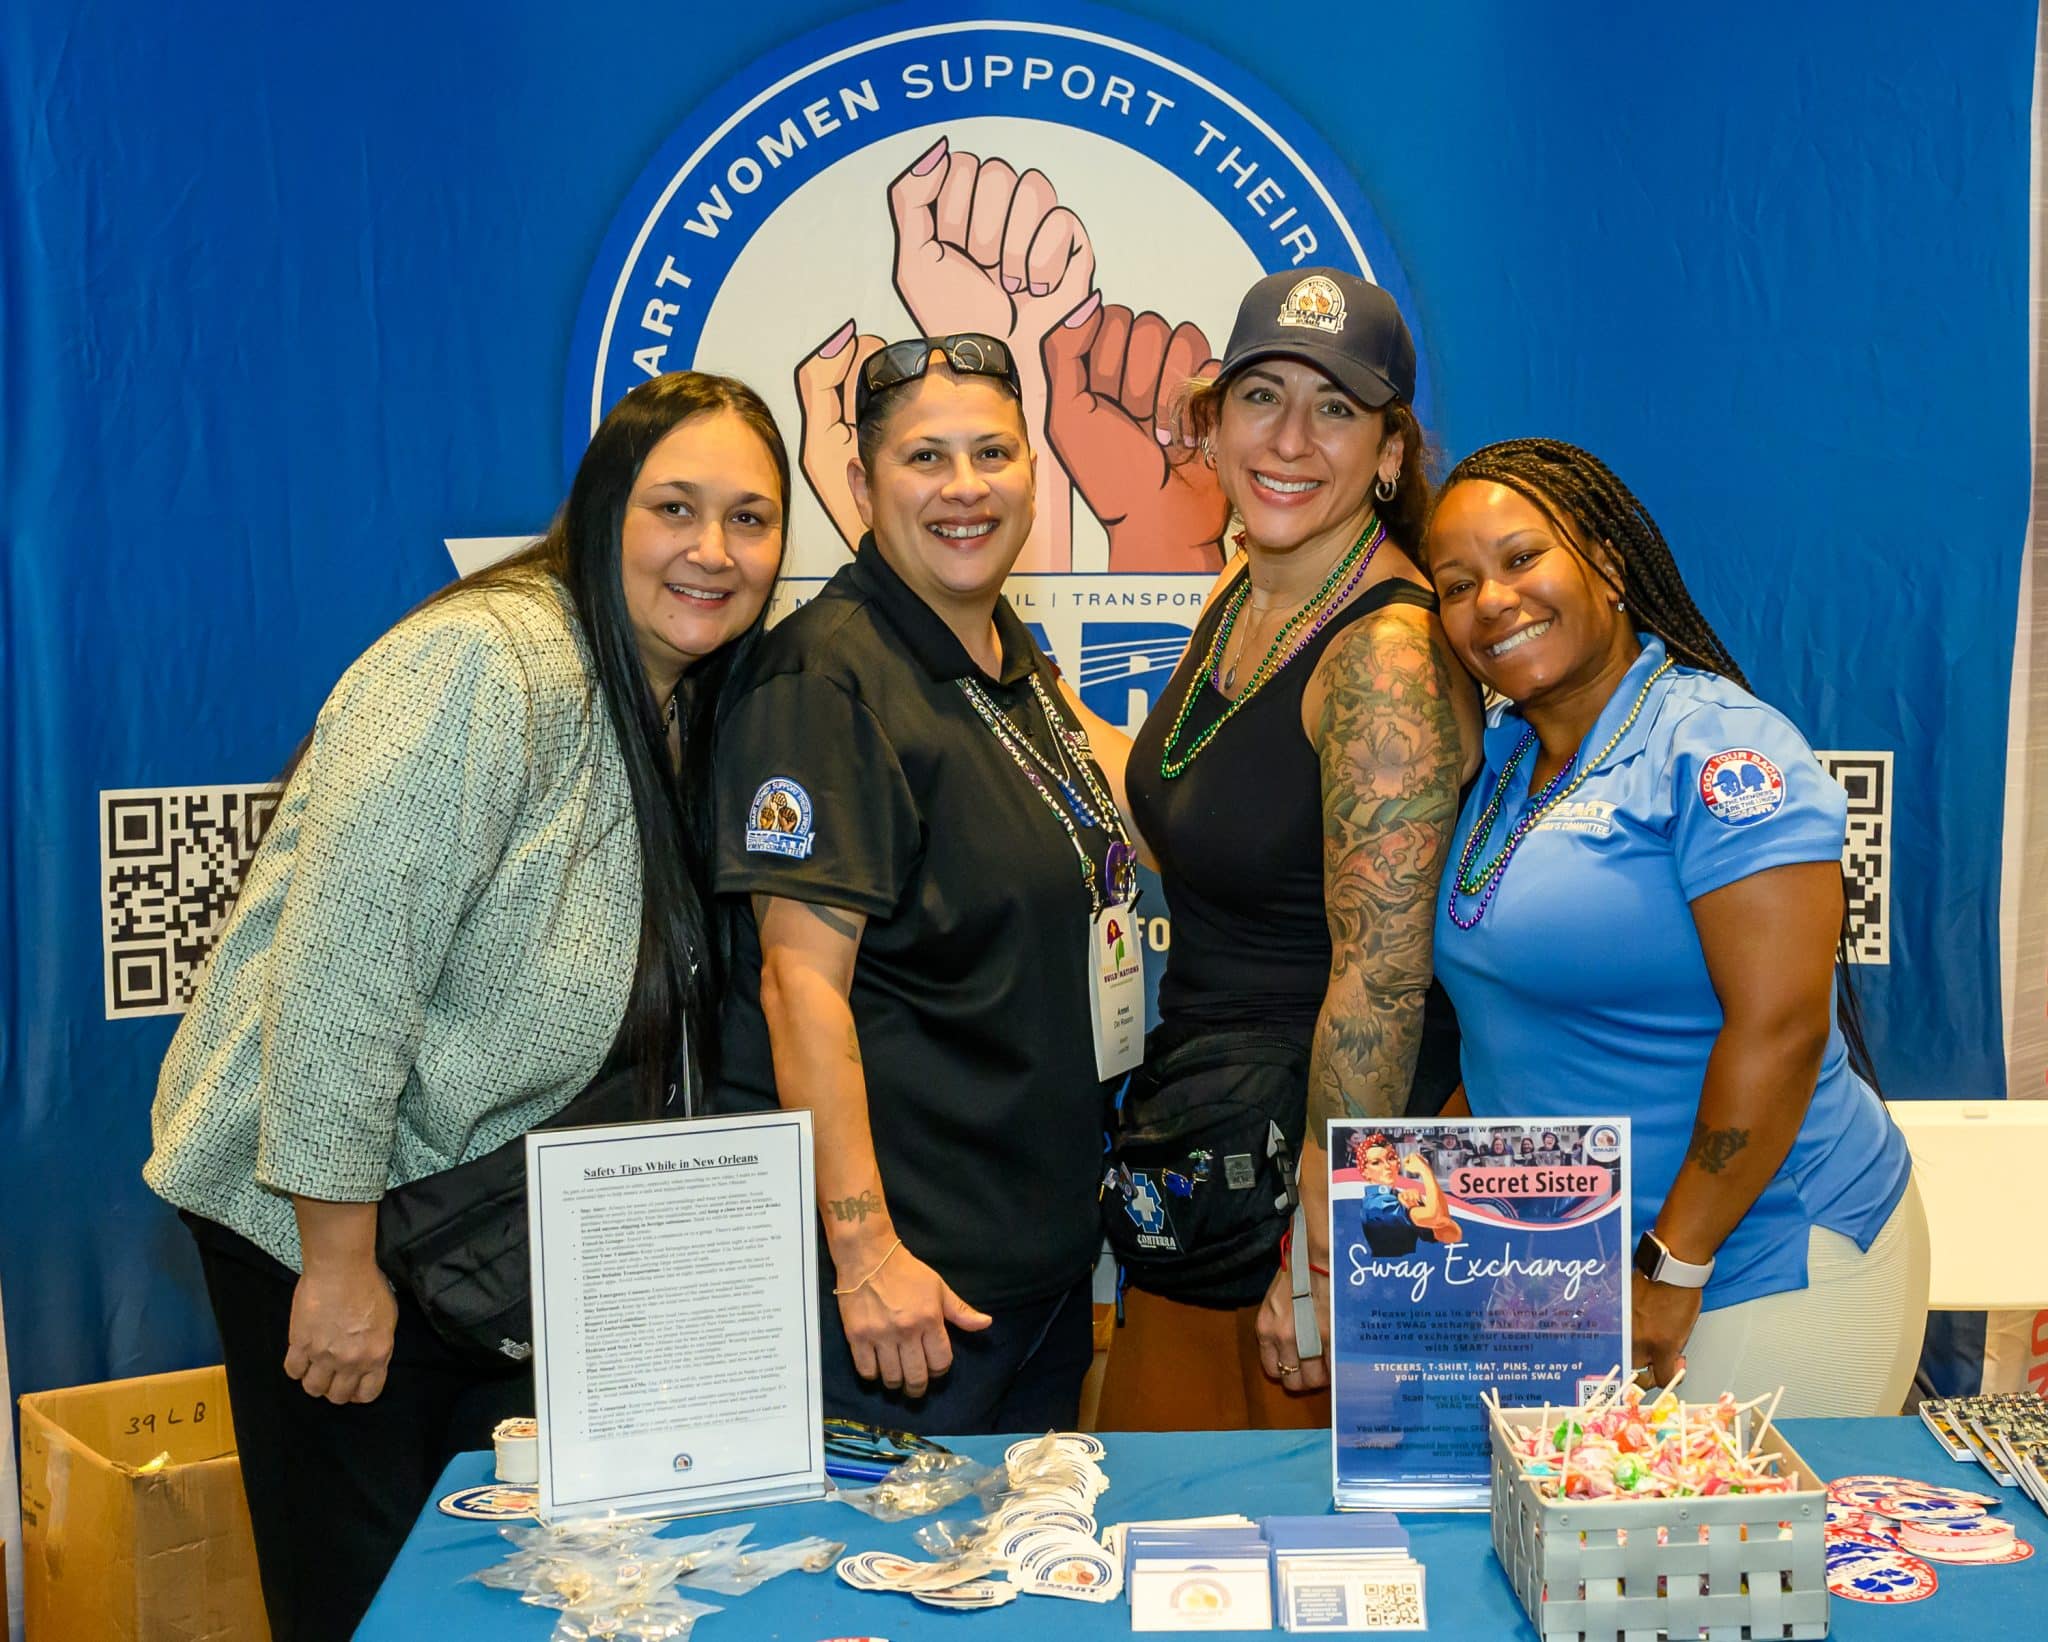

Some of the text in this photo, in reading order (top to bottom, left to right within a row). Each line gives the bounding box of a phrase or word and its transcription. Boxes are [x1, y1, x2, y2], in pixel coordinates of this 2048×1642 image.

[628, 54, 1320, 394] ART WOMEN SUPPORT THEIR
[1072, 593, 1209, 606] TRANSPOR
[1703, 763, 1717, 792] GOT
[1714, 751, 1748, 768] YOUR
[1749, 754, 1781, 783] BACK
[584, 1153, 759, 1178] Safety Tips While in New Orleans
[1459, 1171, 1599, 1194] Secret Sister
[1348, 1242, 1606, 1302] Swag Exchange
[1373, 1362, 1425, 1372] STICKERS,
[1428, 1362, 1472, 1372] T-SHIRT,
[1475, 1362, 1500, 1372] HAT,
[1503, 1362, 1532, 1372] PINS,
[1549, 1363, 1569, 1373] any
[1571, 1362, 1584, 1370] of
[1394, 1372, 1562, 1383] your favorite local union SWAG
[124, 1414, 156, 1435] 39
